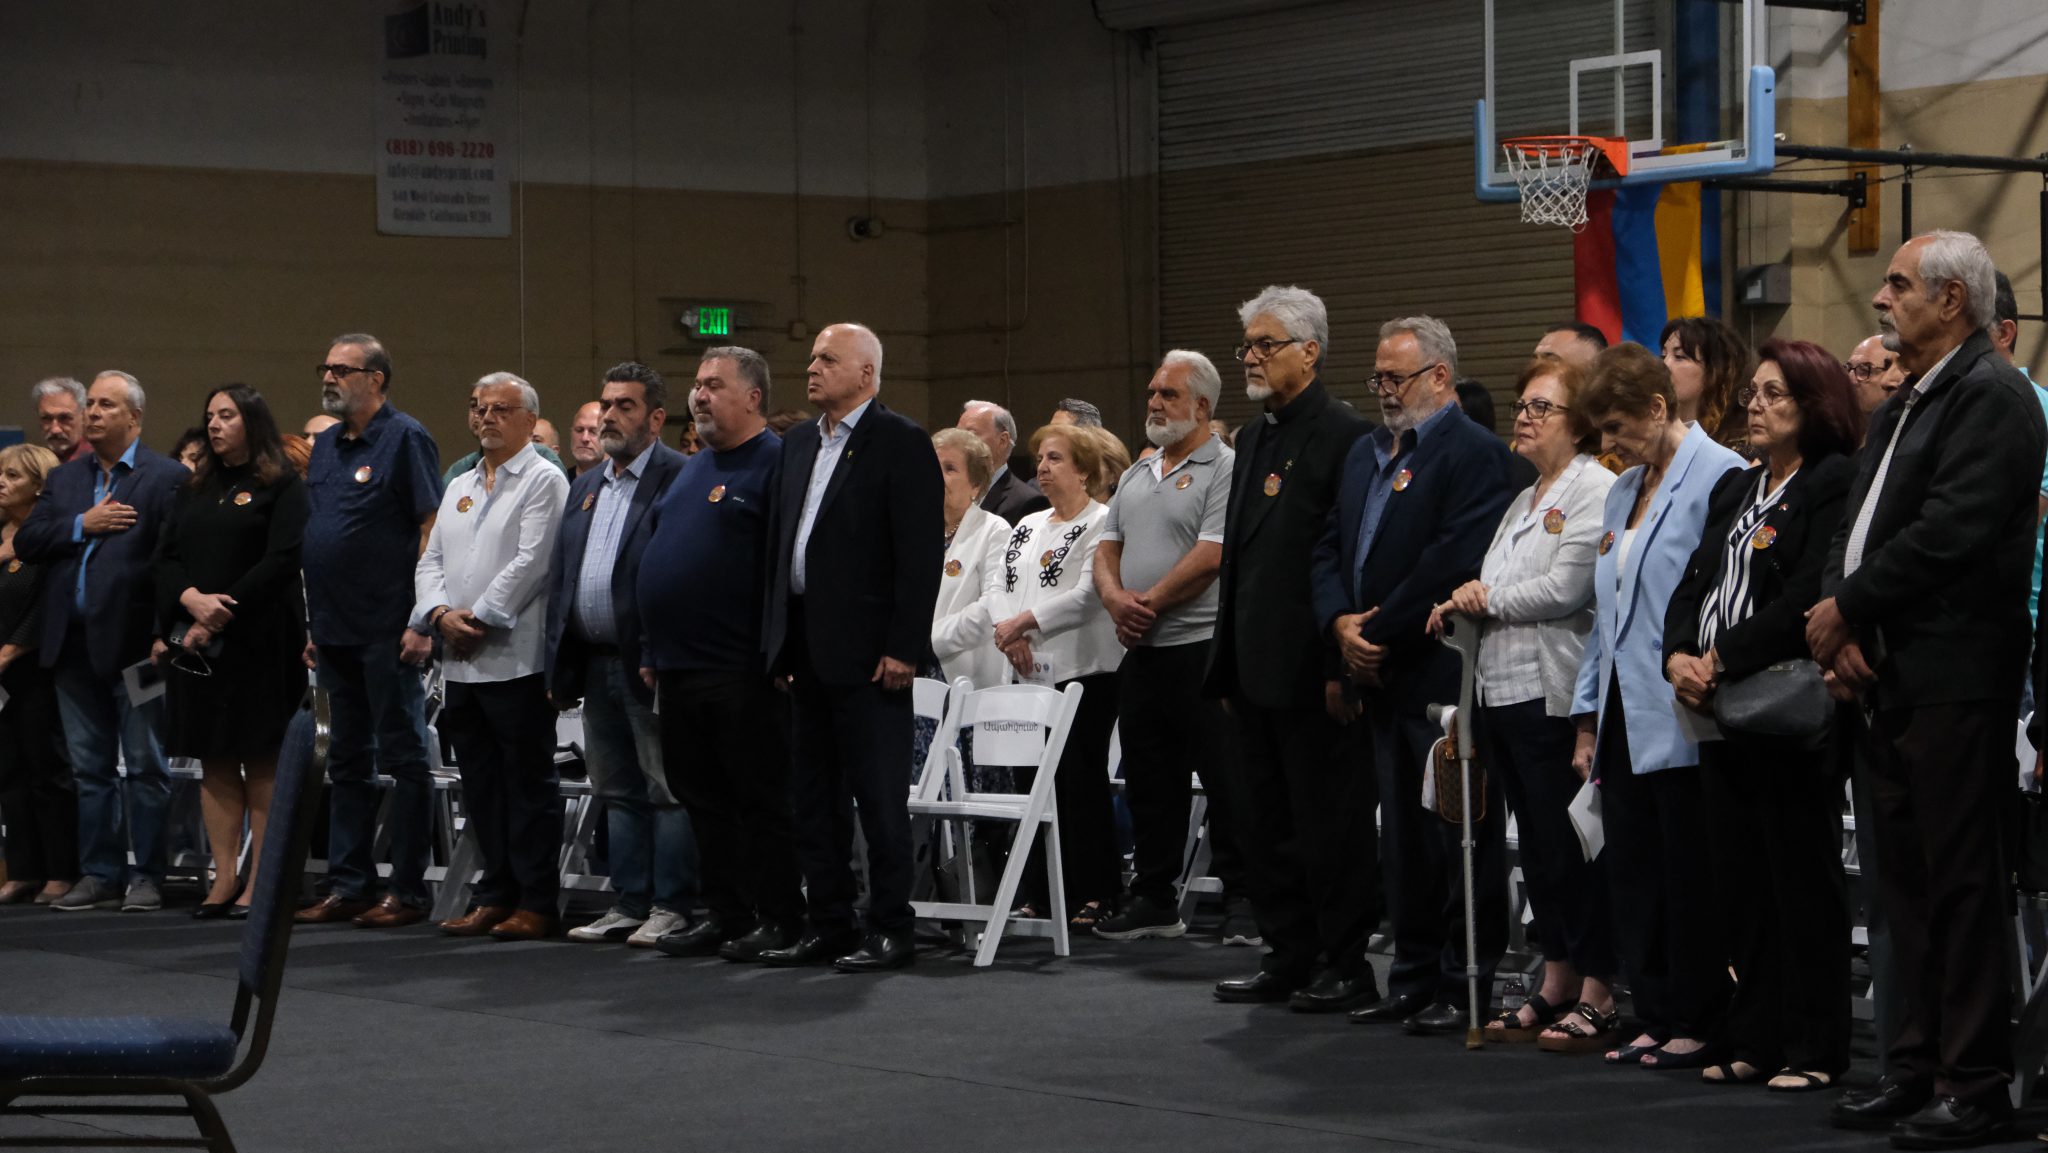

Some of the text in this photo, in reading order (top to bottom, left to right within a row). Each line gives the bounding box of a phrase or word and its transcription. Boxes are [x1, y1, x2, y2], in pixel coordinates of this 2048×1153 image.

[433, 1, 487, 31] Andy's
[433, 29, 488, 60] Printing
[386, 139, 495, 159] (818) 696-2220
[466, 191, 491, 205] Street
[699, 307, 729, 335] EXIT
